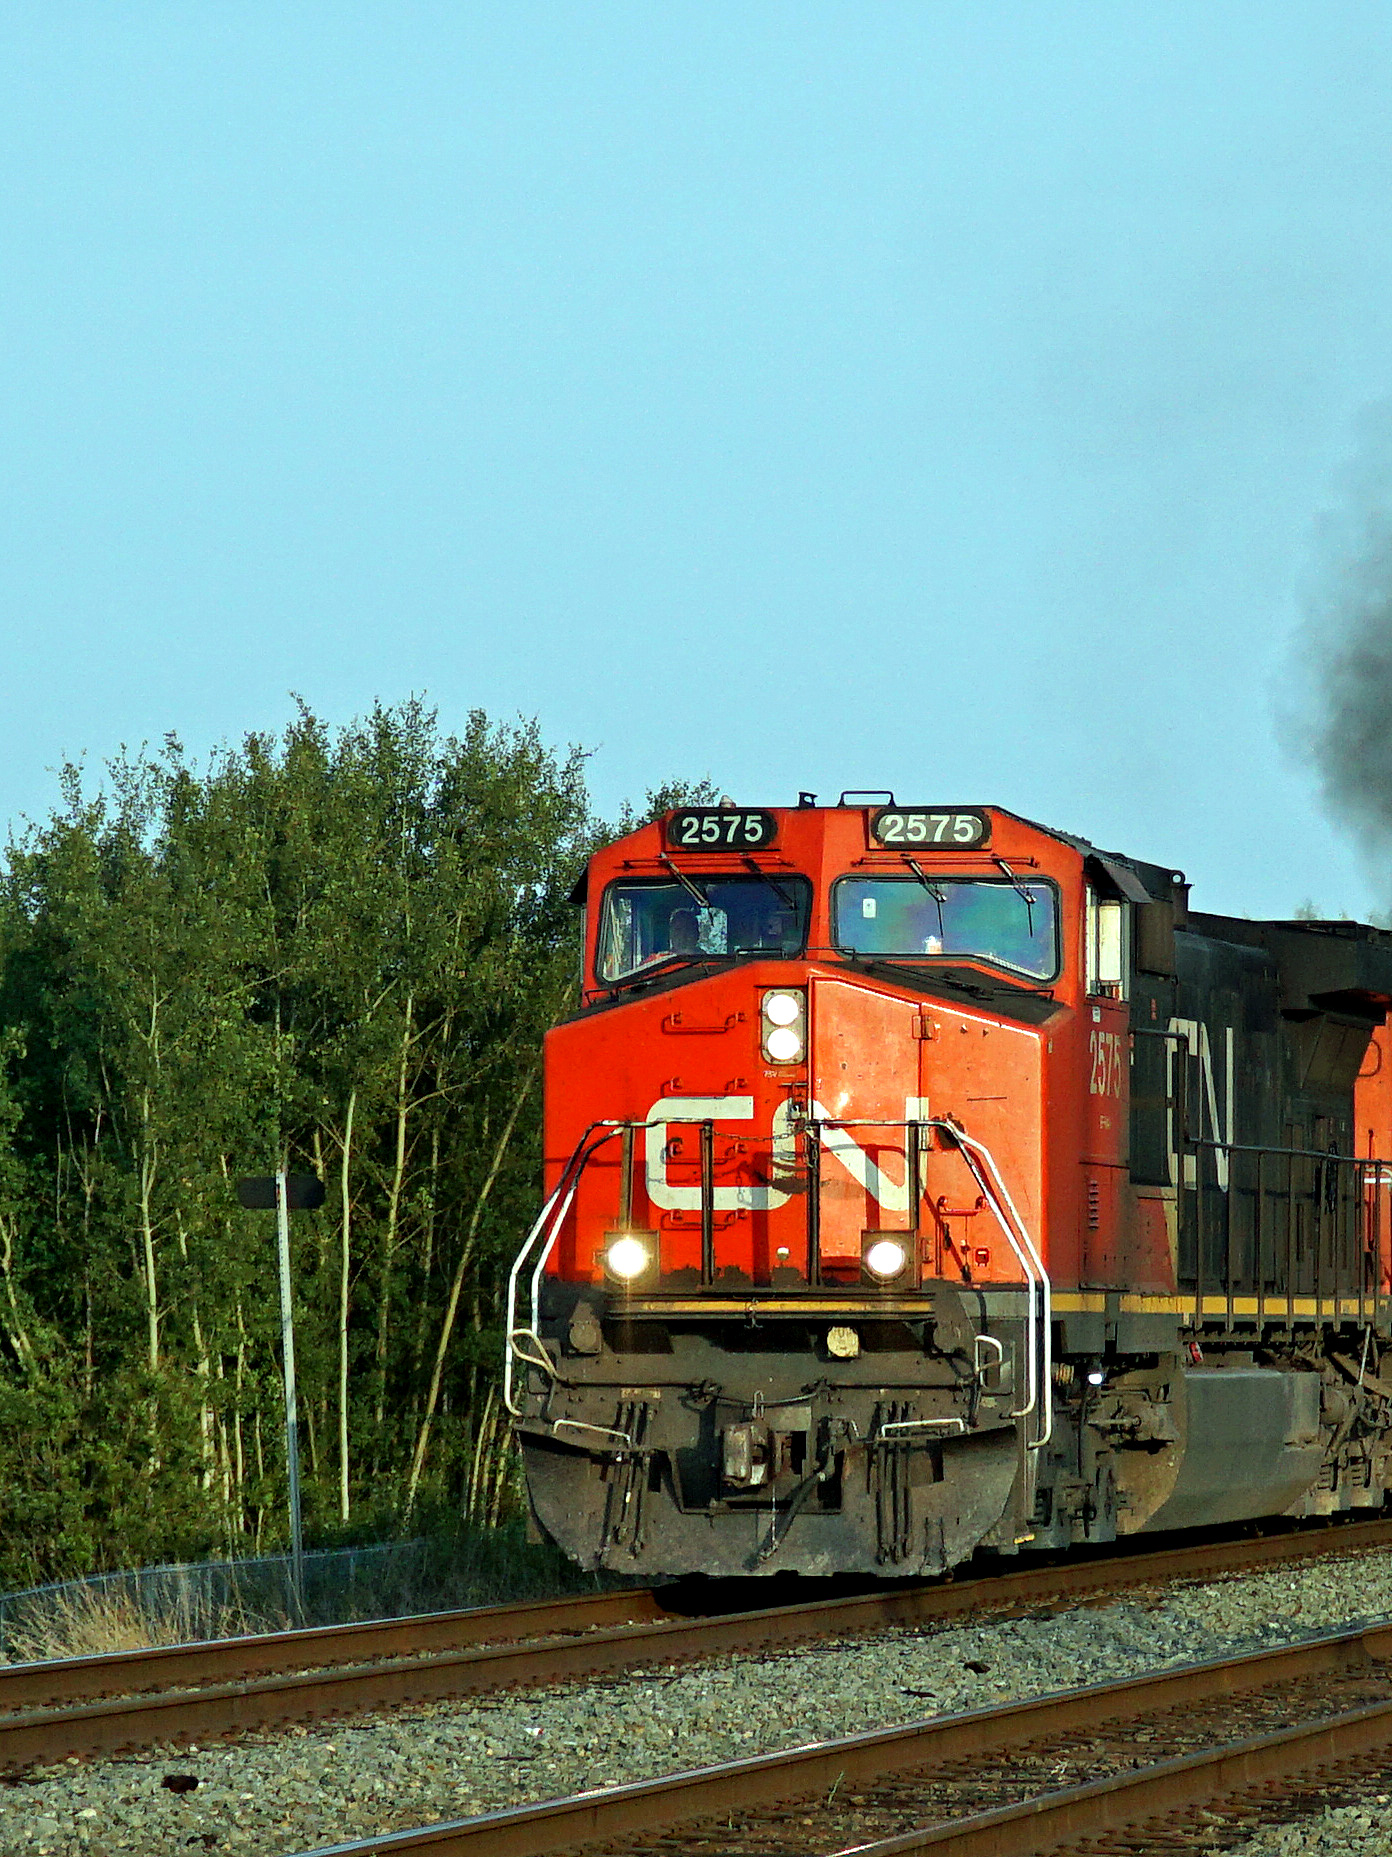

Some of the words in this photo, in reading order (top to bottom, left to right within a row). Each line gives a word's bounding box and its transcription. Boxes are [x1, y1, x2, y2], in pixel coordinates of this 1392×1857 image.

[681, 814, 764, 844] 2575
[883, 814, 975, 844] 2575
[1090, 1030, 1121, 1098] 2575
[1166, 1017, 1234, 1193] CN
[645, 1096, 930, 1212] CN
